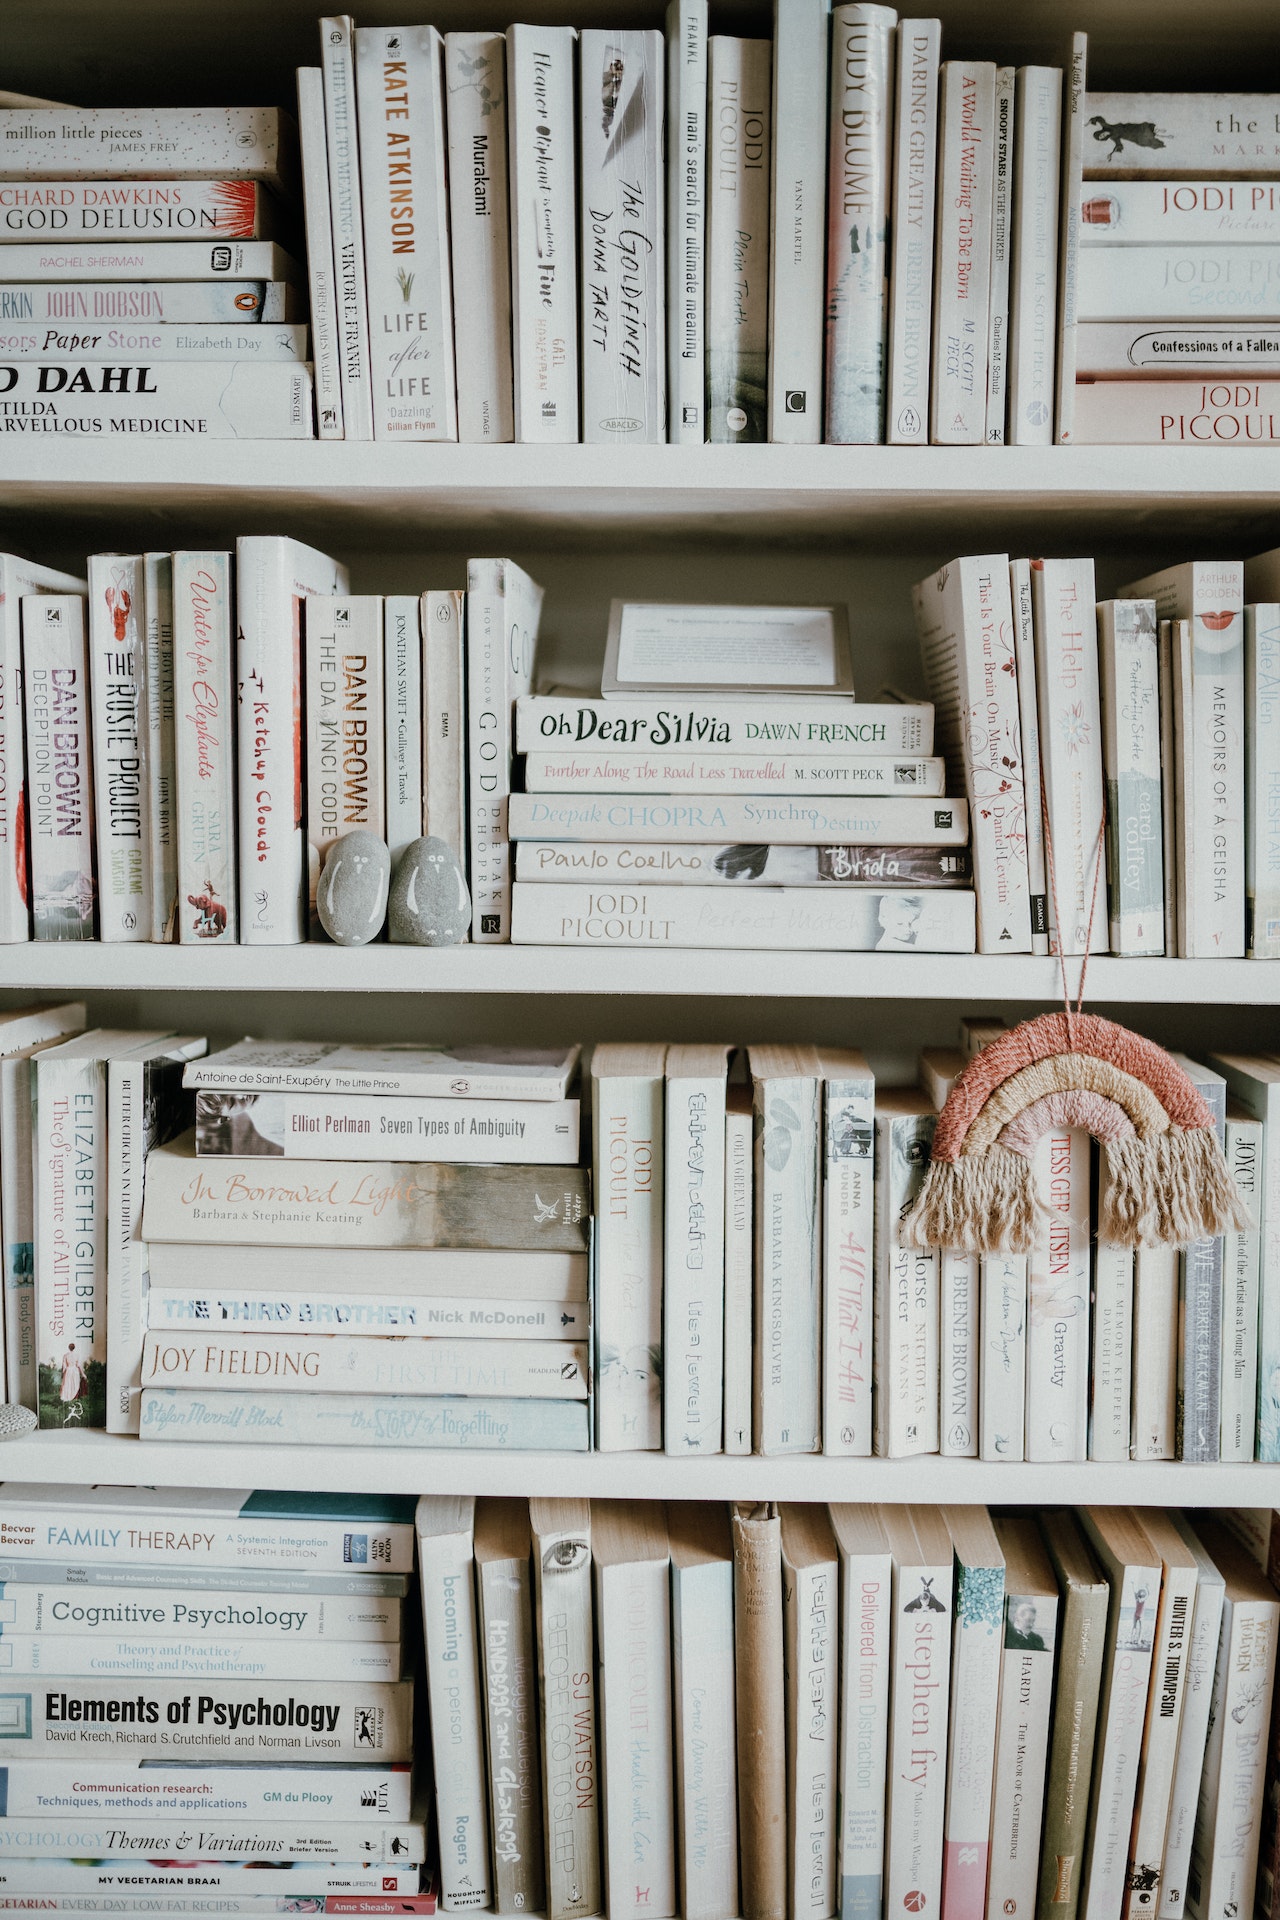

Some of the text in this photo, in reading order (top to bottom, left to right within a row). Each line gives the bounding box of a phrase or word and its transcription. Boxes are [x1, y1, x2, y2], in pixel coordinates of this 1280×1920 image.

[6, 126, 142, 142] million little pieces
[532, 53, 552, 194] Eleanor Oliphant
[906, 37, 928, 228] DARING GREATLY
[109, 143, 178, 152] JAMES FREY
[384, 62, 415, 254] KATE ATKINSON
[472, 135, 490, 216] Murakami
[996, 99, 1008, 262] SNOOPY STARS AS THE THINKER
[84, 188, 180, 206] DAWKINS
[619, 180, 644, 218] The
[6, 208, 218, 229] GOD DELUSION
[683, 112, 701, 358] man's search for ultimate meaning
[794, 180, 803, 265] YANN MARTEL
[342, 242, 357, 301] VIKTOR
[589, 209, 613, 352] DONNA TARTT
[46, 291, 164, 318] JOHN DOBSON
[42, 330, 161, 352] Paper Stone
[176, 336, 262, 350] Elizabeth Day
[345, 321, 362, 383] FRANKL
[1152, 340, 1278, 352] Confessions of a Fallen
[36, 367, 158, 394] DAHL
[110, 419, 208, 433] MEDICINE
[482, 400, 490, 435] VINTAGE
[396, 616, 408, 804] JONATHAN SWIFT Gulliver's Travels
[576, 708, 647, 742] Dear
[650, 711, 732, 744] Silvia
[746, 723, 801, 740] DAWN
[806, 724, 886, 742] FRENCH
[32, 670, 54, 837] DECEPTION POINT
[52, 670, 82, 836] DAN BROWN
[320, 634, 340, 836] THE DA VINCI CODE
[342, 656, 368, 823] DAN BROWN
[106, 684, 141, 840] ROSIE PROJECT
[794, 768, 884, 780] M. SCOTT PECK
[252, 703, 272, 862] Ketchup Clouds
[1214, 687, 1226, 902] MEMOIRS OF A GEISHA
[536, 847, 900, 878] Paulo Coelho Brida
[588, 895, 646, 916] JODI
[1036, 898, 1044, 930] EGMONT
[561, 919, 675, 940] PICOULT
[194, 1072, 400, 1089] Antoine de Saint-Exupéry The Little Prince
[292, 1115, 525, 1138] Elliot Perlman Seven Types of Ambiguity
[610, 1116, 626, 1220] PICOULT
[631, 1140, 652, 1192] JODI
[75, 1095, 93, 1343] ELIZABETH GILBERT
[194, 1208, 362, 1226] Barbara & Stephanie Keating
[771, 1193, 782, 1385] BARBARA KINGSOLVER
[20, 1296, 32, 1366] Body Surfing
[428, 1310, 544, 1325] Nick McDonell
[150, 1344, 320, 1378] JOY FIELDING
[952, 1276, 970, 1416] BRENÉ BROWN
[1051, 1322, 1068, 1388] Gravity
[48, 1528, 216, 1552] FAMILY THERAPY
[52, 1601, 307, 1630] Cognitive Psychology
[860, 1583, 880, 1656] Delivered
[1160, 1597, 1188, 1718] HUNTER S. THOMPSON
[860, 1663, 878, 1698] from
[1018, 1656, 1032, 1706] HARDY
[46, 1693, 340, 1732] Elements of Psychology
[902, 1622, 940, 1787] stephen fry
[572, 1673, 593, 1809] SJ WATSON
[856, 1706, 876, 1788] Distraction
[37, 1796, 247, 1811] Techniques, methods and applications
[73, 1782, 212, 1794] Communication research:
[264, 1792, 333, 1805] GM du Plooy
[106, 1830, 284, 1852] Themes & Variations
[118, 1877, 184, 1885] VEGETARIAN
[334, 1902, 396, 1913] Anne Sheasby
